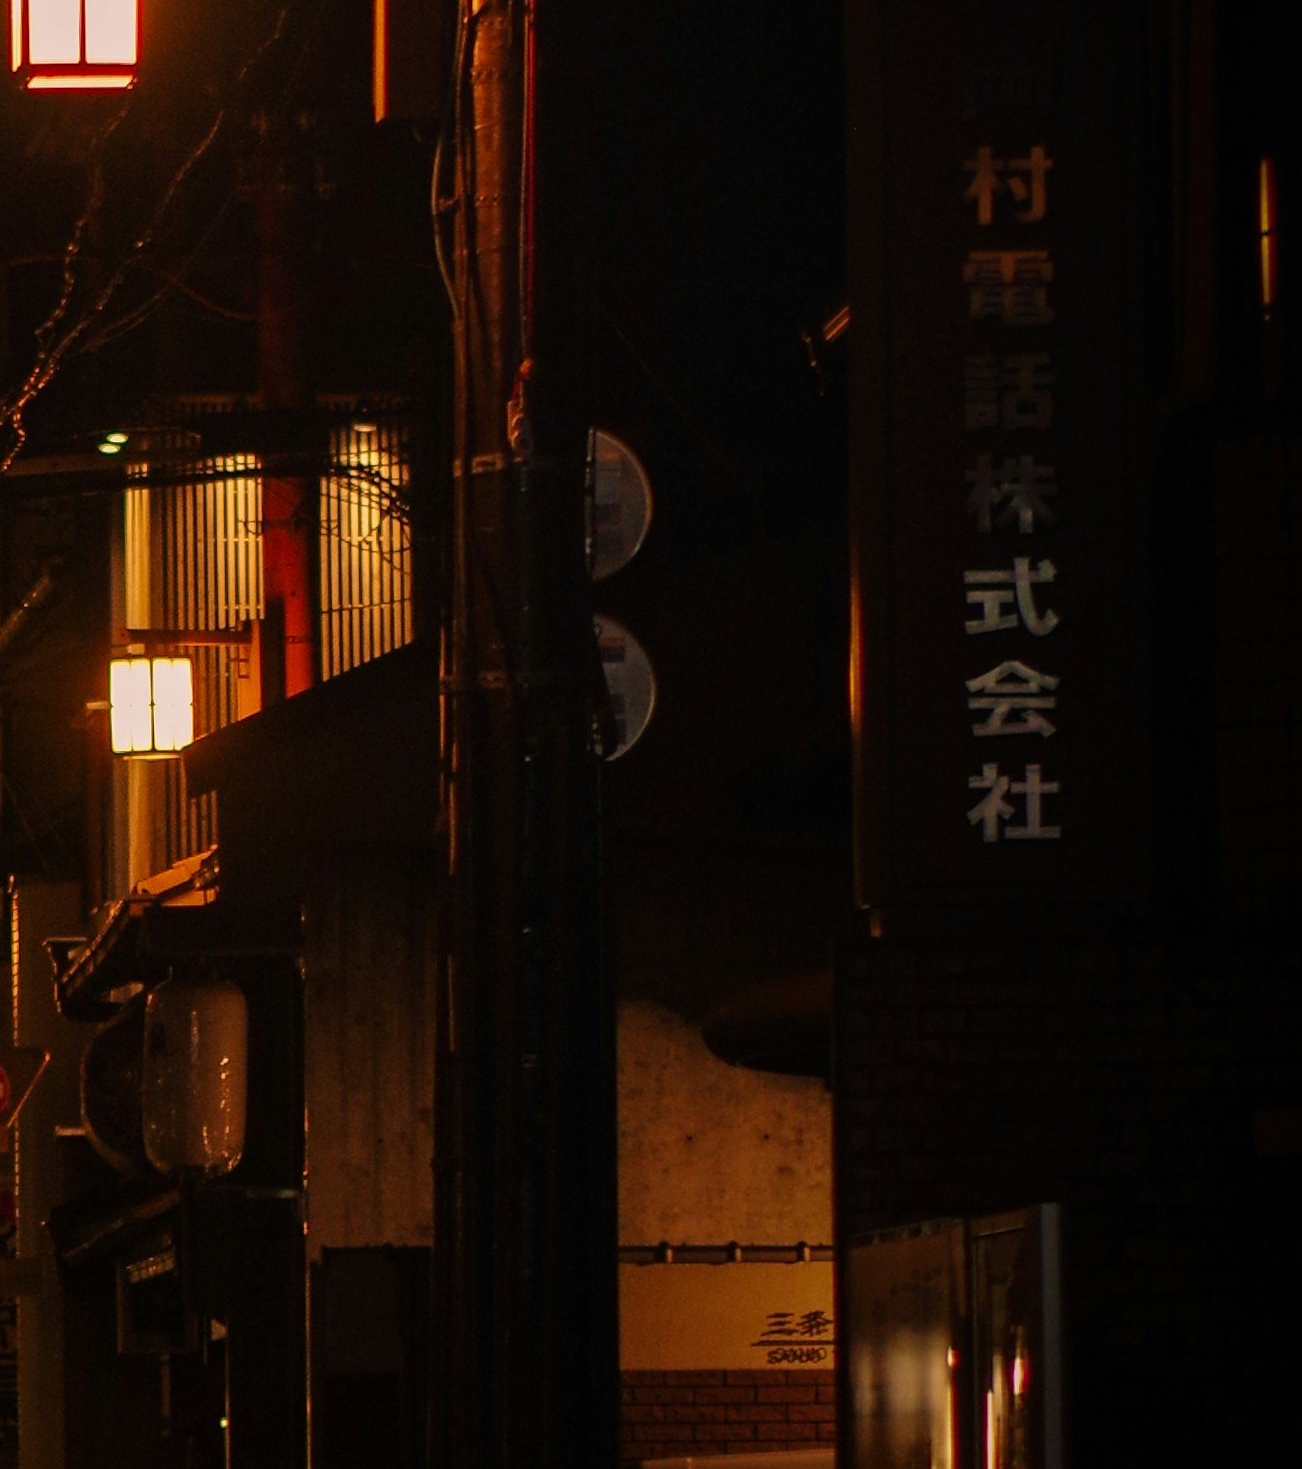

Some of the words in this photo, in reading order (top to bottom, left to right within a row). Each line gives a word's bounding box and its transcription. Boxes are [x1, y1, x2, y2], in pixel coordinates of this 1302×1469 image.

[961, 51, 1062, 845] 村電話株式会社
